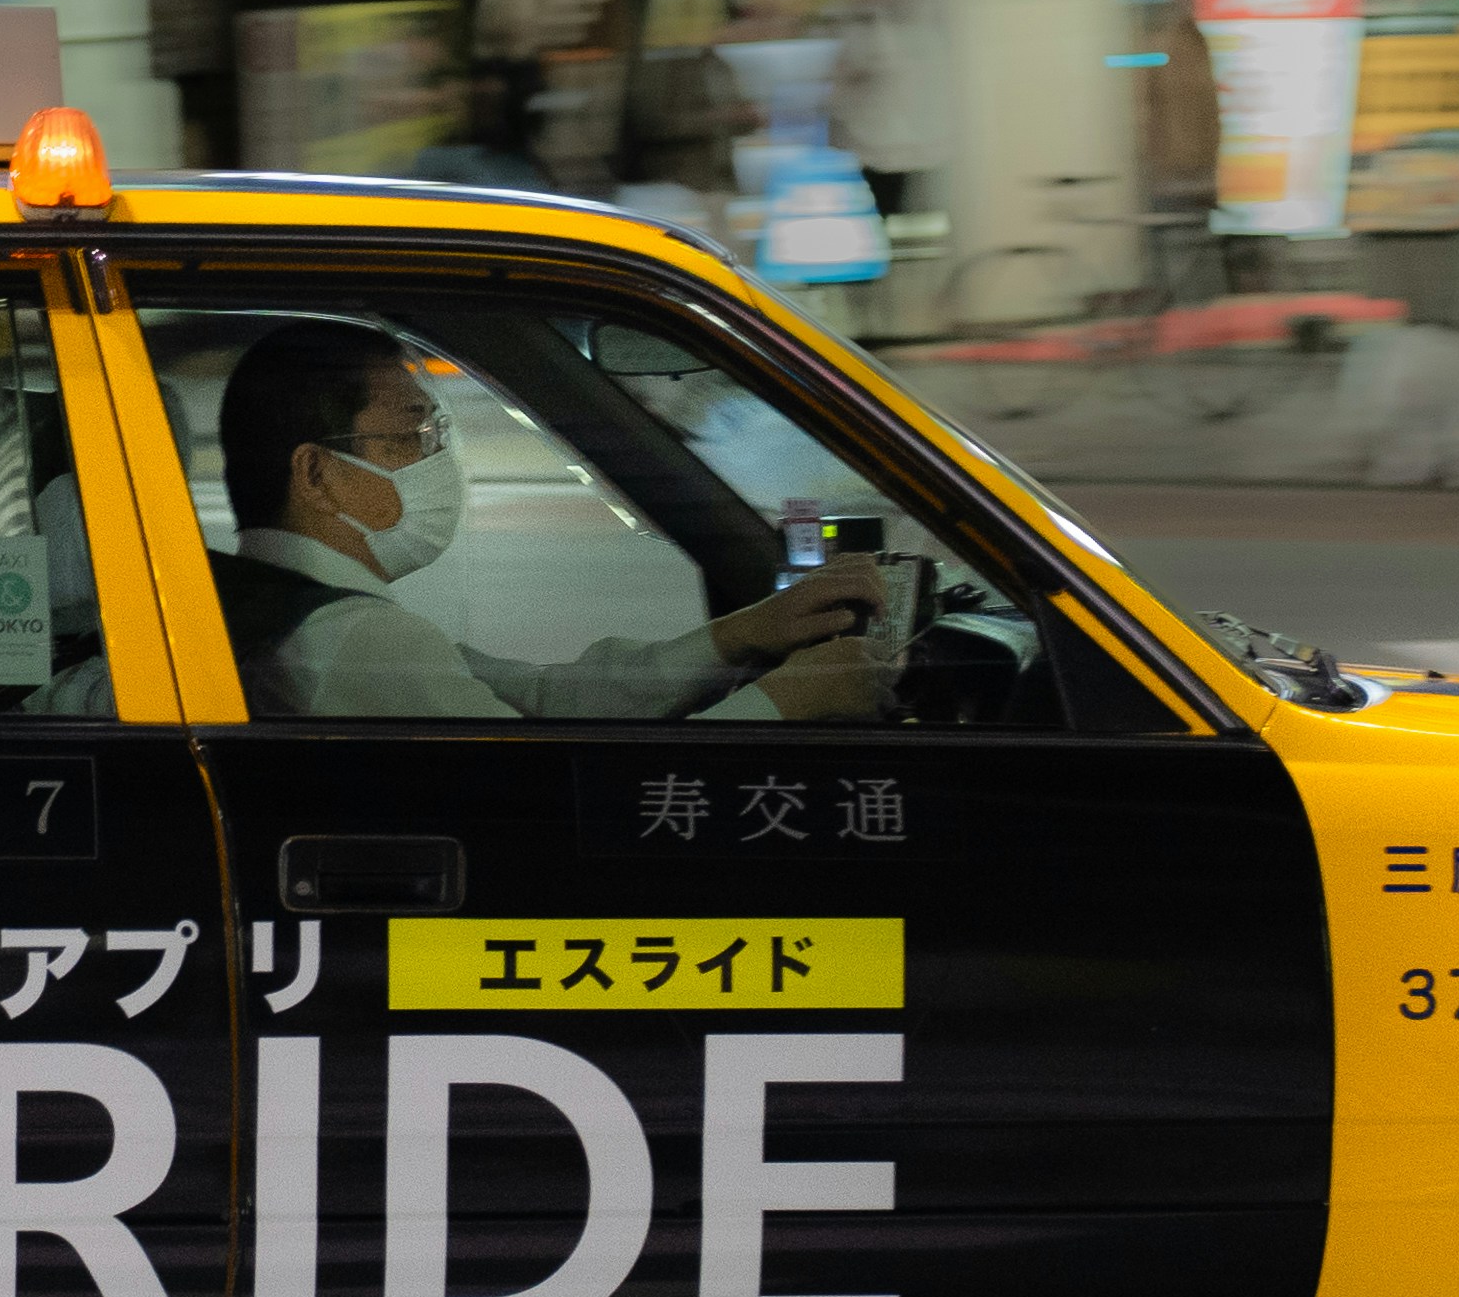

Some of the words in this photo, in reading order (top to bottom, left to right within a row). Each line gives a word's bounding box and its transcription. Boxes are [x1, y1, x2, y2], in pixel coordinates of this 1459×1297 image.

[638, 773, 909, 842] 寿交通
[478, 935, 813, 994] エスライド
